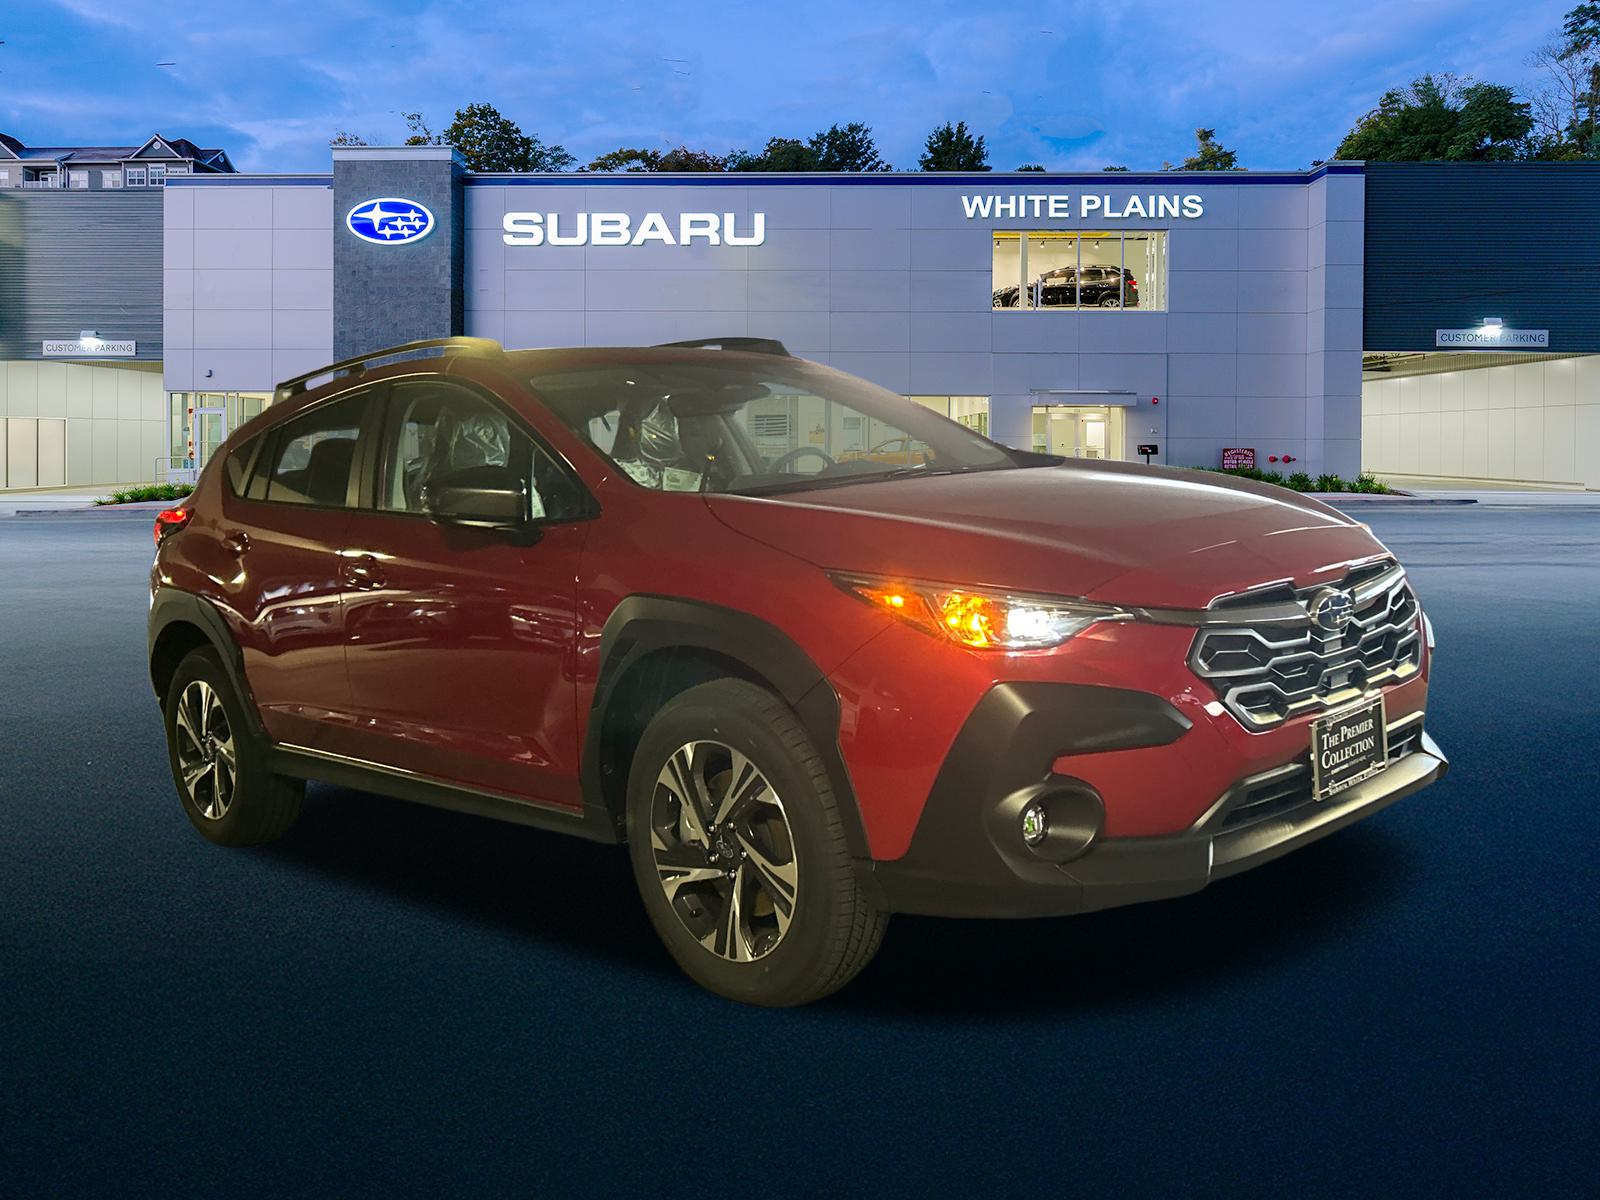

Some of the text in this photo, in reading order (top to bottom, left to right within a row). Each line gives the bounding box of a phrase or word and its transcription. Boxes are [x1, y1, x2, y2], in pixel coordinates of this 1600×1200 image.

[961, 194, 1204, 219] WHITE PLAINS
[502, 212, 766, 247] SUBARU
[95, 343, 133, 353] PARKING
[1440, 333, 1545, 343] CUSTOMER PARKING
[1321, 719, 1374, 750] THE PREMIER
[1321, 735, 1375, 769] COLLECTION
